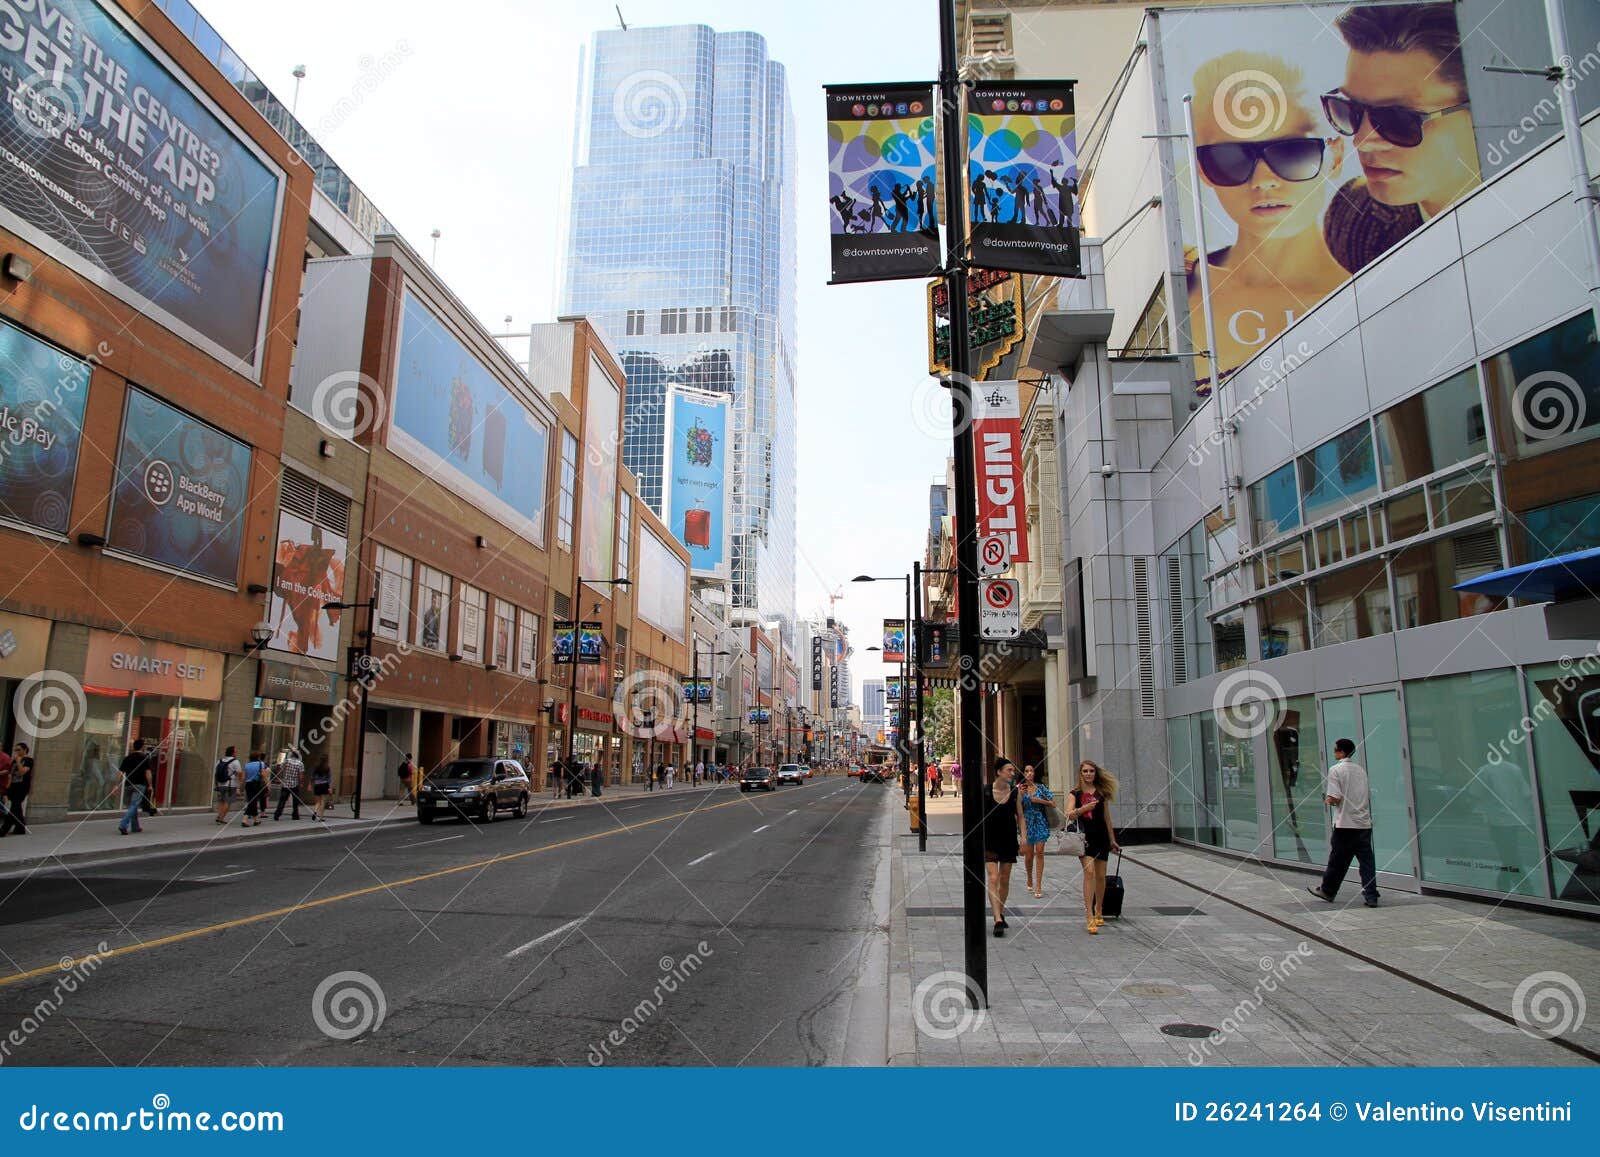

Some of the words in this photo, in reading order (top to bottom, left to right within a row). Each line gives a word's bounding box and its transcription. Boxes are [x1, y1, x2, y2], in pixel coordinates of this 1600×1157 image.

[0, 0, 74, 90] GET
[83, 70, 148, 158] THE
[153, 141, 216, 206] APP
[81, 33, 128, 98] THE
[132, 84, 220, 177] CENTRE?
[836, 94, 886, 102] DOWNTOWN
[5, 86, 61, 139] Toronto
[64, 132, 102, 171] Eaton
[103, 163, 142, 201] Centre
[143, 195, 167, 222] App
[0, 146, 96, 219] TOEATONCENTRE.COM
[79, 126, 94, 144] at
[95, 137, 116, 161] the
[117, 153, 149, 188] heart
[150, 183, 163, 199] of
[173, 202, 187, 218] all
[188, 213, 210, 237] with
[842, 245, 929, 257] @downtownyonge
[983, 238, 1069, 251] @downtownyonge
[22, 417, 56, 450] play
[179, 475, 225, 507] BlackBerry
[177, 494, 196, 515] App
[196, 501, 223, 522] World
[281, 579, 293, 591] am
[294, 582, 306, 595] the
[307, 586, 341, 603] Collection
[111, 652, 173, 676] SMART
[175, 663, 208, 681] SET
